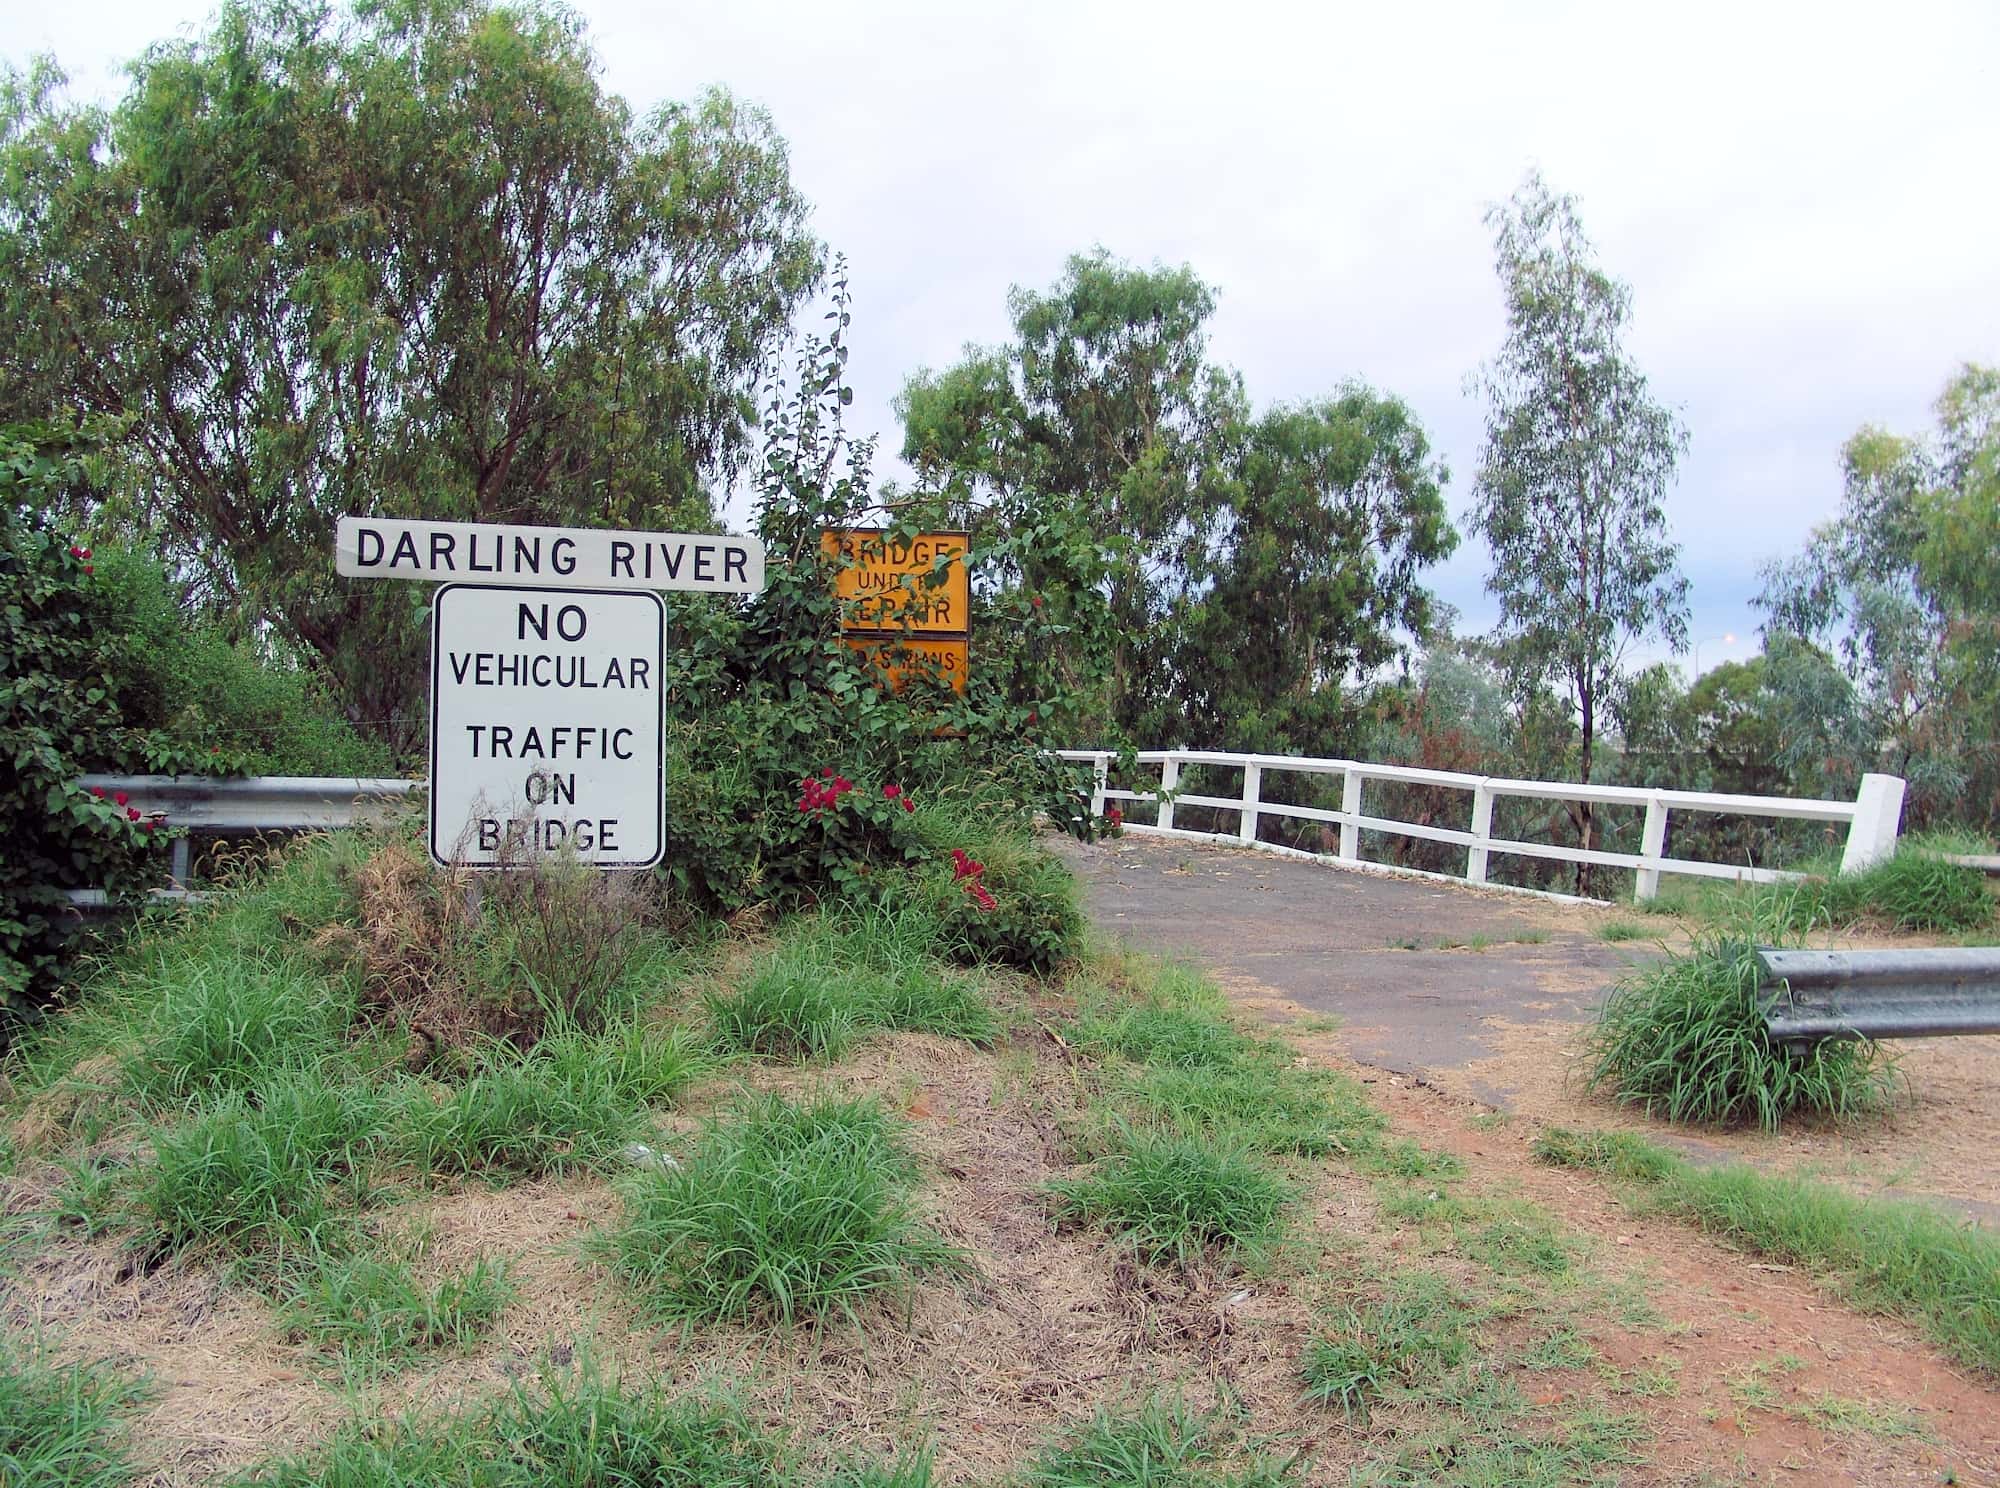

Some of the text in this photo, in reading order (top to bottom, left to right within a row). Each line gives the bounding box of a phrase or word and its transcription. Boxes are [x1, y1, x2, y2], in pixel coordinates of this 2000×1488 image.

[357, 528, 748, 583] DARLING RIVER
[518, 603, 588, 642] NO
[449, 652, 650, 689] VEHICULAR
[465, 726, 634, 760] TRAFFIC
[525, 772, 576, 805] ON
[478, 818, 619, 852] BRIDGE
